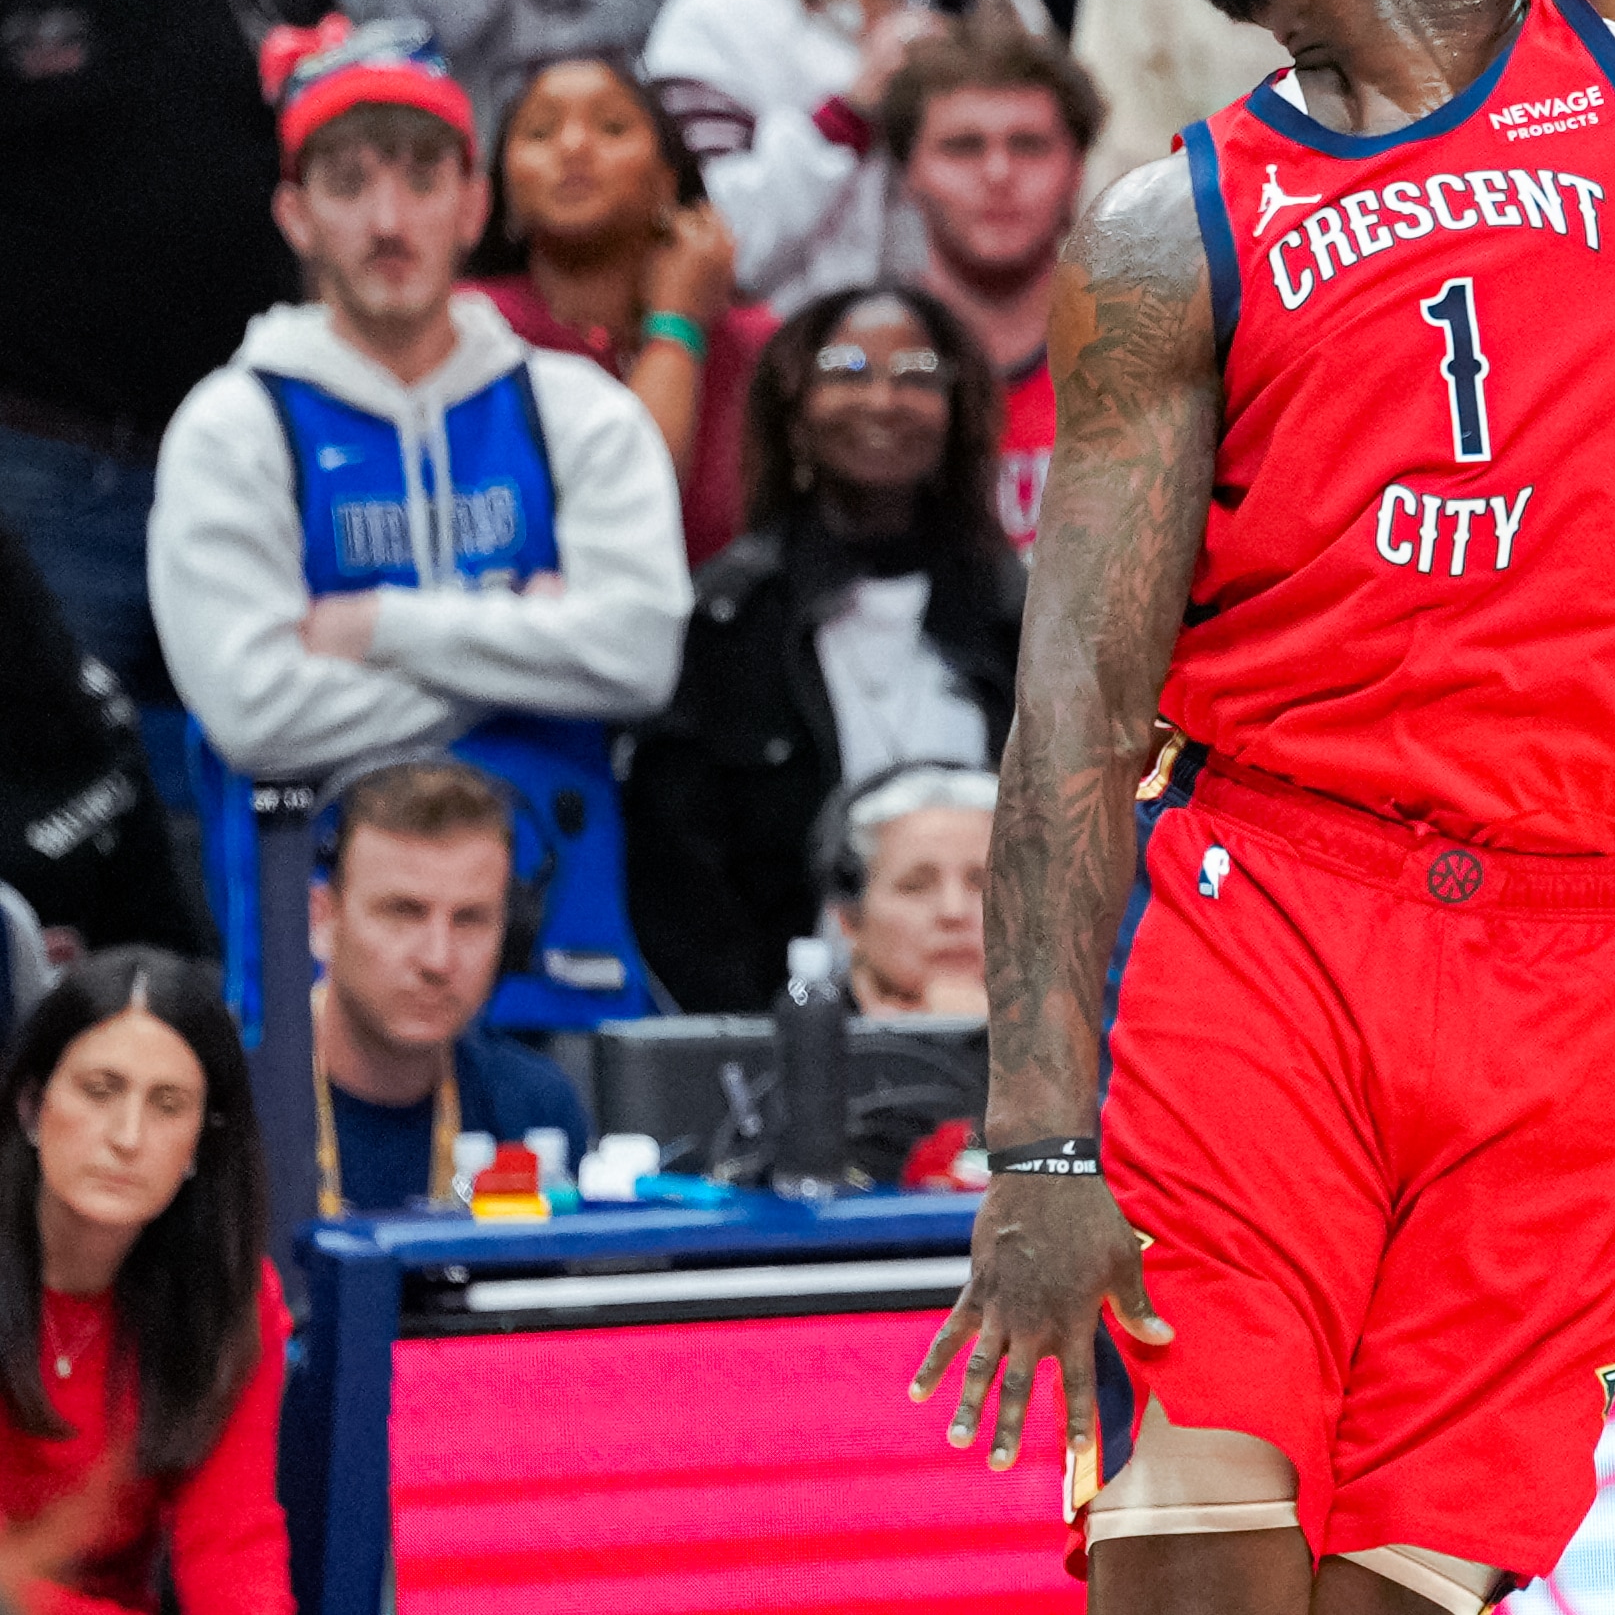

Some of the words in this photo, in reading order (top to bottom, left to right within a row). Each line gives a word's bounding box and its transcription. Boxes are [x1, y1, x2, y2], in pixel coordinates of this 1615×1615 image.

[1488, 85, 1605, 130] NEWAGE
[1506, 112, 1599, 142] PRODUCTS
[1267, 168, 1606, 311] CRESCENT
[1420, 276, 1492, 463] 1
[1376, 483, 1534, 577] CITY
[1046, 1159, 1069, 1174] TO
[1072, 1159, 1097, 1174] DIE
